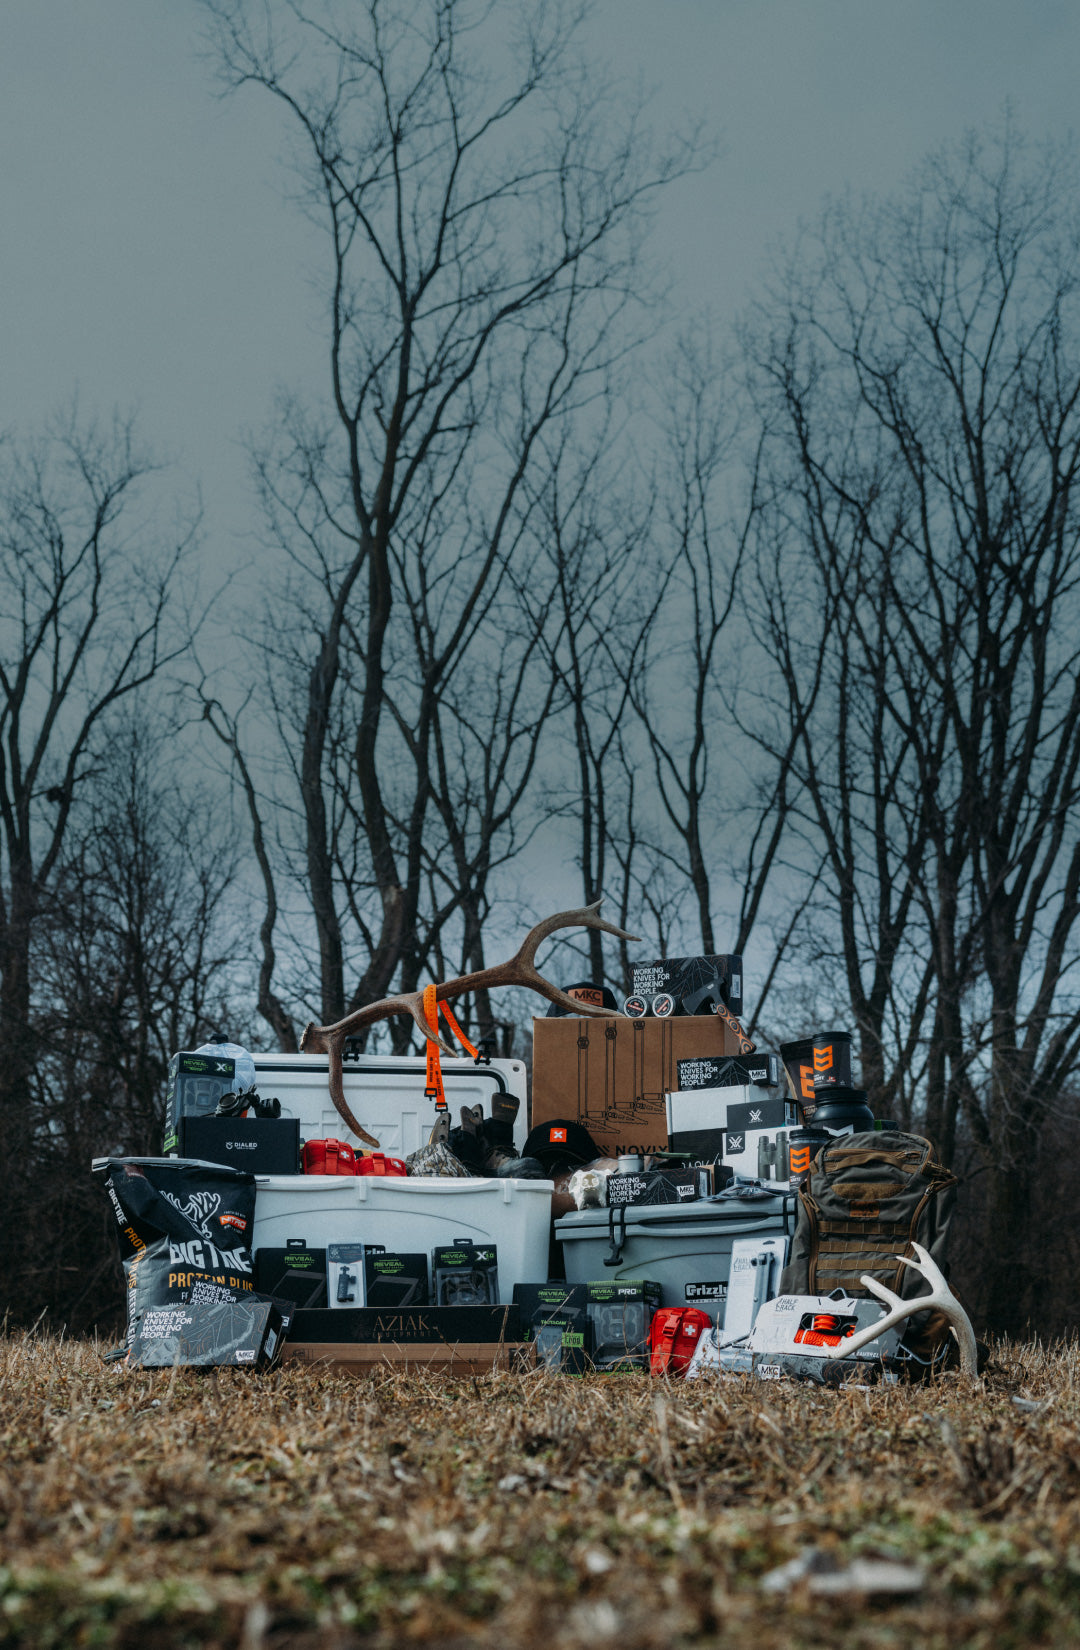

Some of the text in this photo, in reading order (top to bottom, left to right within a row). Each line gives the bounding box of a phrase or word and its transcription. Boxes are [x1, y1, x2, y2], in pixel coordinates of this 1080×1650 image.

[633, 967, 664, 976] WORKING
[633, 973, 671, 982] KNIVES FOR
[633, 980, 664, 989] WORKING
[574, 990, 601, 1000] MKC
[680, 1061, 712, 1069] WORKING
[680, 1067, 704, 1075] KNIVES
[609, 1177, 640, 1185] WORKING
[609, 1183, 632, 1191] KNIVES
[679, 1186, 694, 1194] MKC
[220, 1216, 246, 1229] NITRO
[195, 1280, 231, 1295] WORKING
[193, 1286, 220, 1299] KNIVES
[221, 1293, 237, 1304] FOR
[175, 1317, 193, 1325] FOR
[373, 1315, 430, 1331] AZIAK
[760, 1365, 779, 1376] MKC
